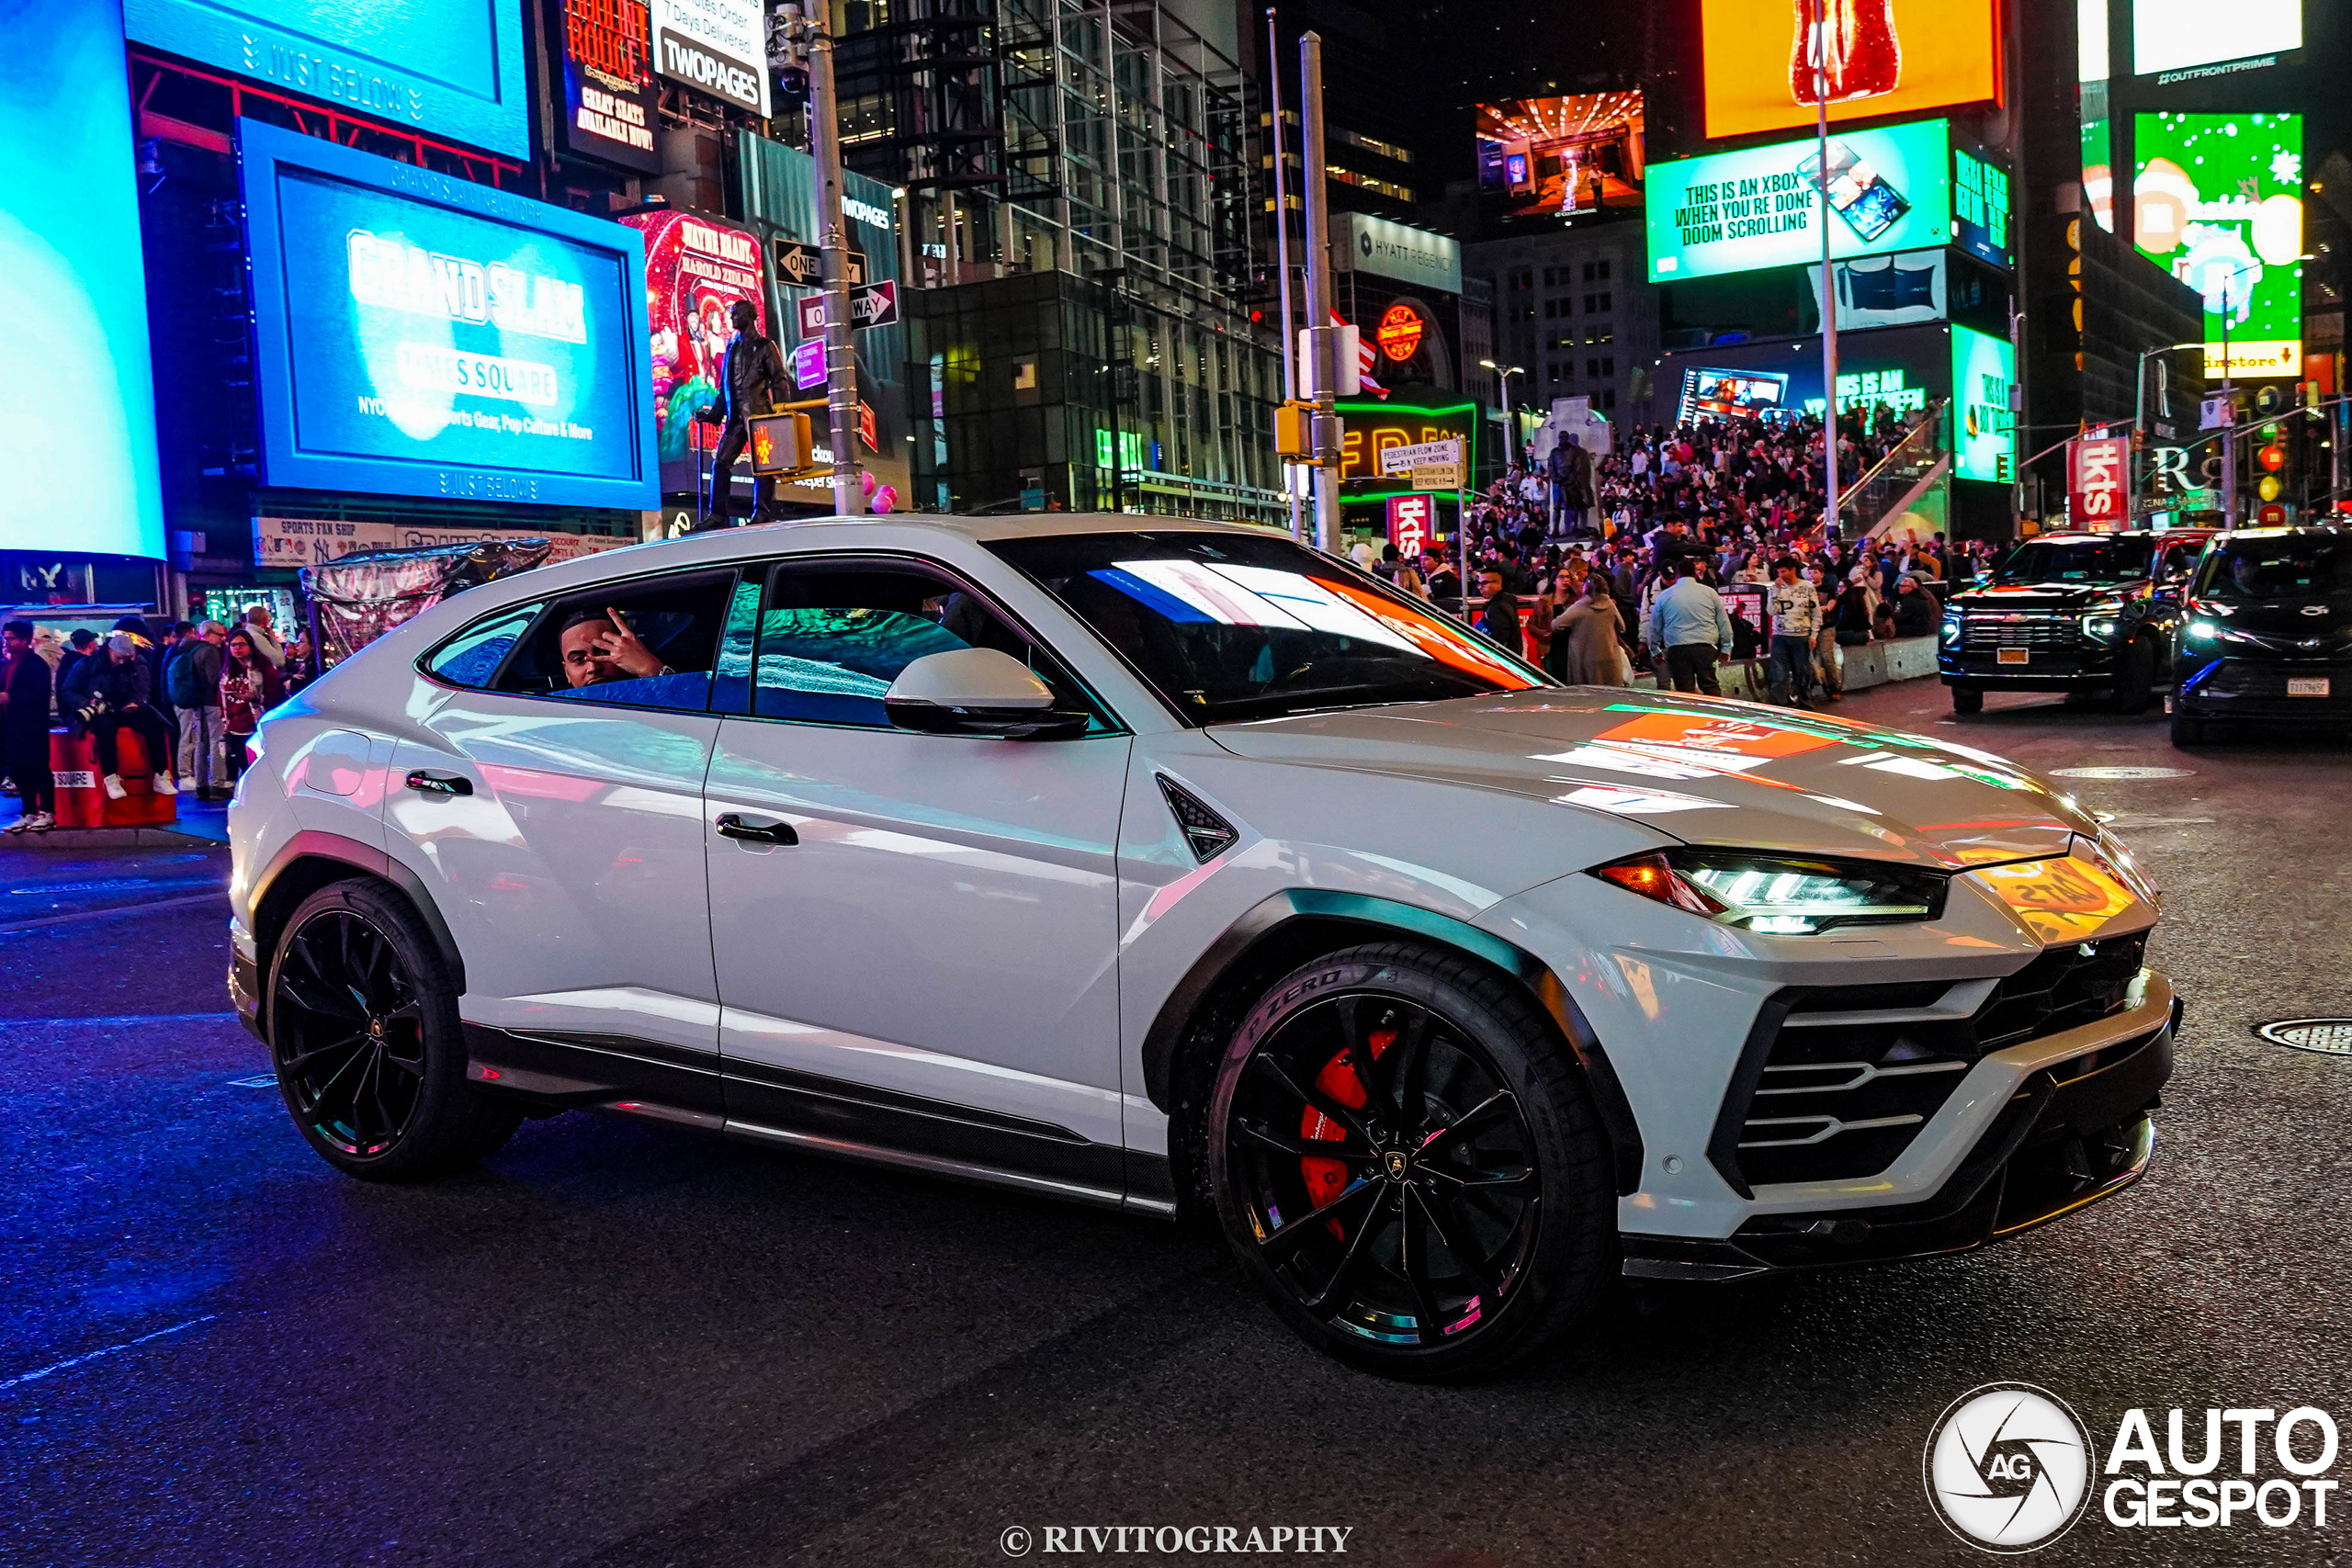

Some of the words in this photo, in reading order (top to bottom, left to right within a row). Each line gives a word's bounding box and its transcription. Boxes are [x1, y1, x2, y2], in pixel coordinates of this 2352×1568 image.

[674, 5, 700, 31] Days
[268, 44, 322, 90] JUST
[330, 63, 402, 111] BELOW
[664, 38, 759, 106] TWOPAGES
[2157, 56, 2278, 86] #OUTFRONTPRIME
[582, 86, 615, 117] GREAT
[616, 97, 645, 127] SEATS
[577, 107, 628, 143] AVAILABLE
[629, 124, 654, 152] NOW!
[1685, 185, 1717, 206] THIS
[1722, 182, 1735, 200] IS
[1739, 178, 1758, 197] AN
[1762, 172, 1800, 194] XBOX
[1675, 206, 1718, 228] WHEN
[1775, 190, 1814, 211] DONE
[1682, 225, 1723, 246] DOOM
[1728, 211, 1807, 241] SCROLLING
[682, 256, 721, 280] HAROLD
[722, 266, 755, 290] ZIDLER
[790, 255, 816, 275] ONE
[1375, 240, 1408, 261] HYATT
[1410, 249, 1454, 272] REGENCY
[346, 228, 488, 326] GRAND
[487, 260, 588, 345] SLAM
[853, 296, 881, 317] WAY
[476, 361, 552, 398] SQUARE
[442, 409, 473, 427] ports
[474, 411, 502, 434] Gear,
[503, 416, 522, 435] Pop
[523, 416, 560, 436] Culture
[560, 421, 567, 437] &
[568, 423, 593, 440] More
[1384, 447, 1418, 460] PEDESTRIAN
[1418, 446, 1432, 456] FLOW
[1434, 444, 1448, 453] ZONE
[1413, 457, 1427, 466] KEEP
[1429, 453, 1450, 464] MOVING
[452, 475, 483, 496] JUST
[487, 477, 529, 500] BELOW
[2083, 444, 2119, 515] tkts
[281, 521, 314, 536] SPORTS
[317, 523, 334, 536] FAN
[336, 524, 356, 536] SHOP
[1398, 498, 1426, 559] tkts
[1267, 970, 1342, 1021] ZERO
